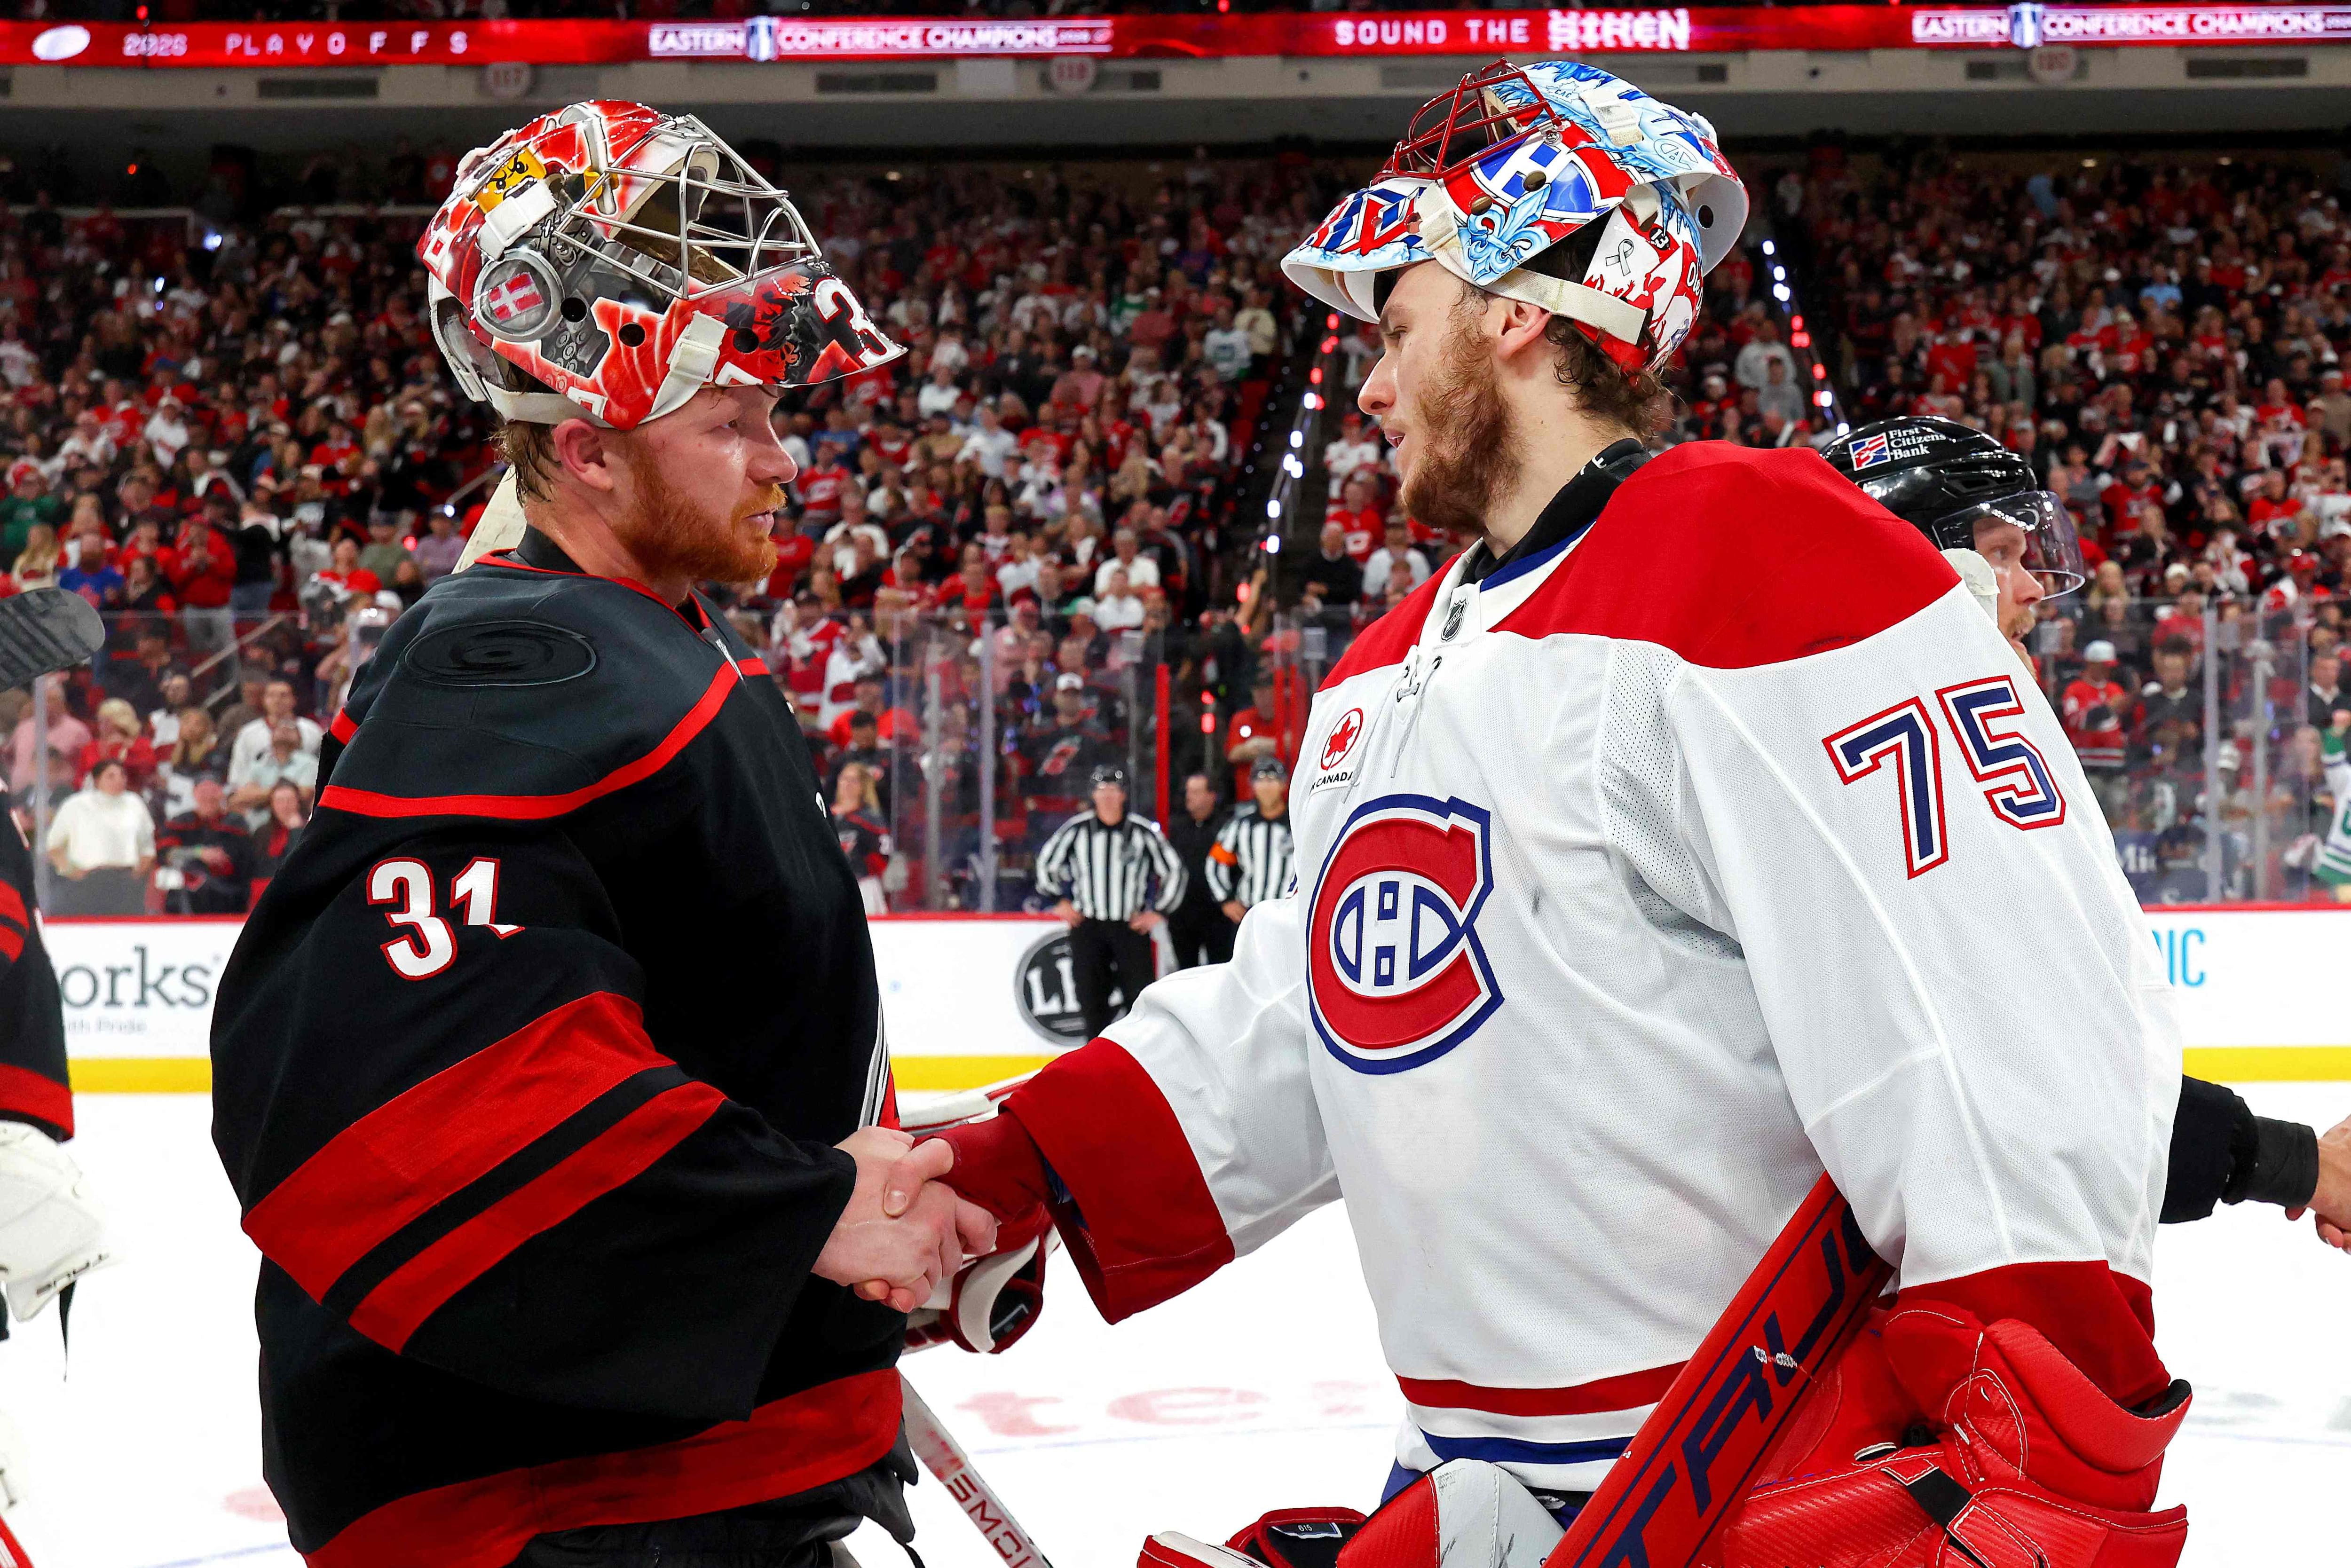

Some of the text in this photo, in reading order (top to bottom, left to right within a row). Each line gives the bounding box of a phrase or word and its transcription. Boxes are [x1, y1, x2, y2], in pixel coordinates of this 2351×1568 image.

[1335, 19, 1447, 46] SOUND
[1465, 19, 1530, 44] THE
[1912, 16, 2009, 38] EASTERN
[2043, 14, 2188, 36] CONFERENCE
[2192, 11, 2325, 33] CHAMPIONS
[649, 29, 746, 52] EASTERN
[778, 28, 921, 48] CONFERENCE
[926, 25, 1057, 48] CHAMPIONS
[1554, 89, 1572, 98] CAC
[1888, 427, 1920, 439] First
[1890, 433, 1947, 448] Citizens
[1893, 443, 1931, 460] Bank
[1822, 675, 2066, 880] 75
[366, 856, 526, 981] 31
